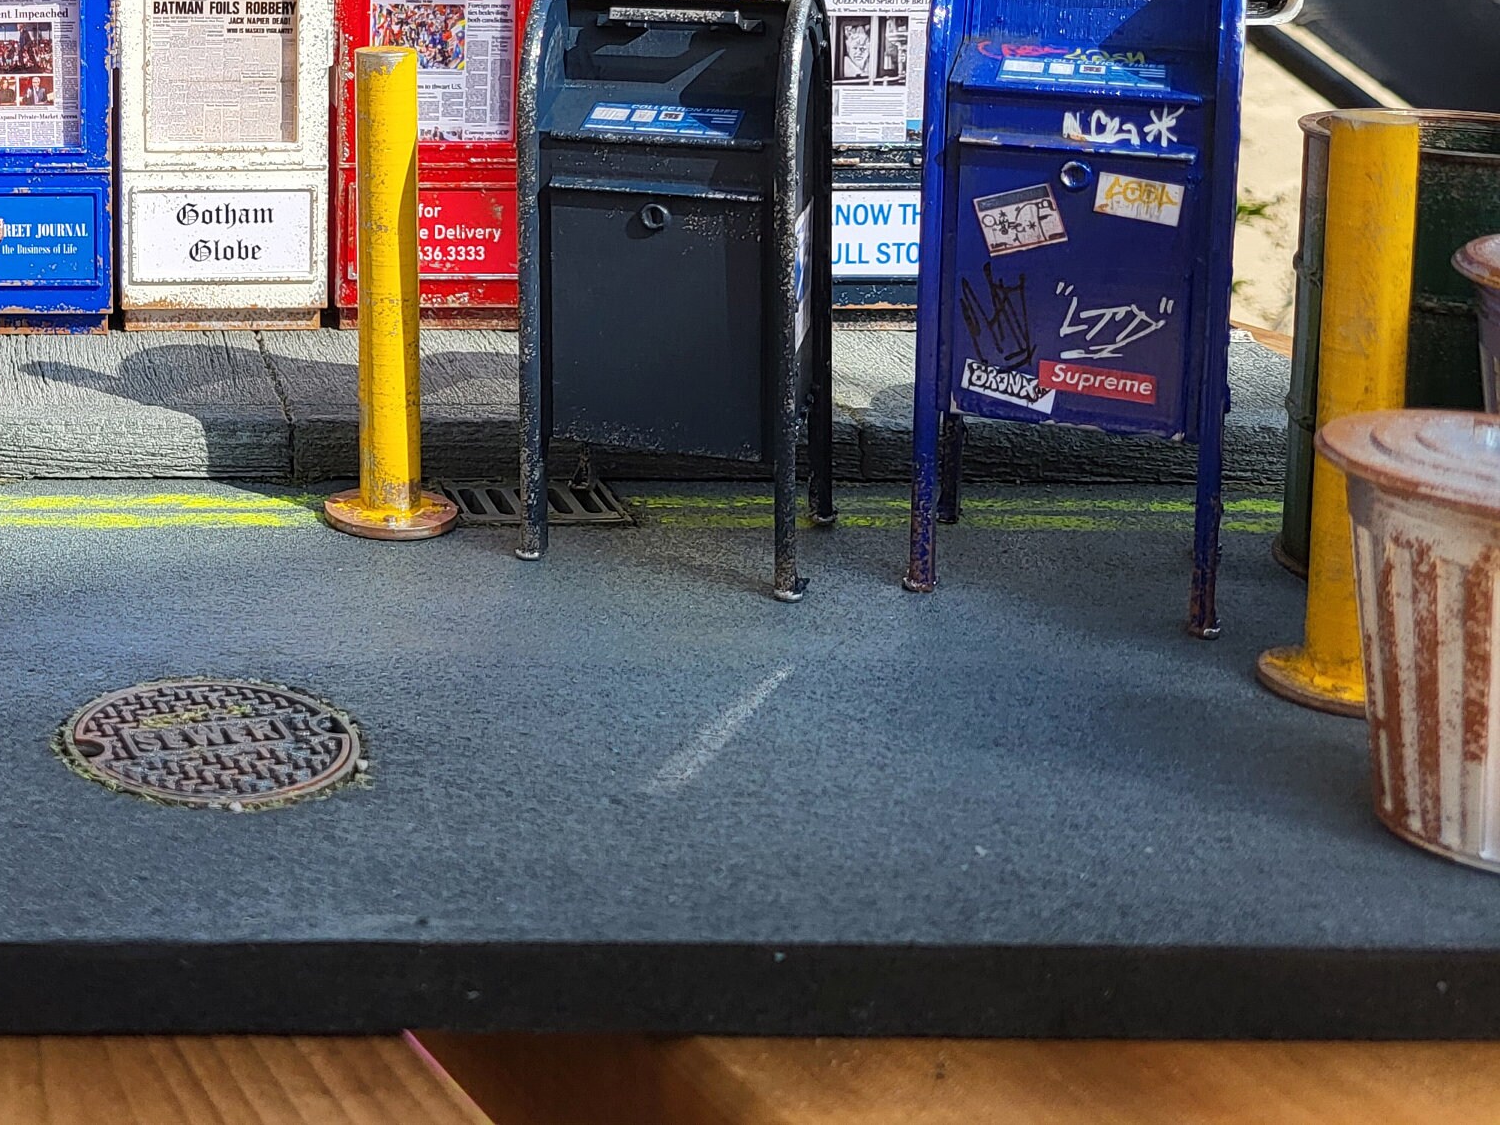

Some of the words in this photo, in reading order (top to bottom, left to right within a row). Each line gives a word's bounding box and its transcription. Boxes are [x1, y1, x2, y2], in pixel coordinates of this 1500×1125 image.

[15, 8, 69, 21] Impeached
[153, 1, 203, 14] BATMAN
[209, 1, 240, 15] FOILS
[245, 1, 297, 15] ROBBERY
[228, 17, 244, 25] JACK
[246, 17, 269, 25] NAPIER
[630, 104, 702, 112] COLLECTION
[175, 202, 275, 229] Gotham
[417, 203, 442, 218] for
[35, 223, 89, 238] JOURNAL
[434, 224, 502, 243] Delivery
[2, 244, 15, 254] the
[17, 244, 51, 255] Business
[52, 244, 62, 254] of
[63, 244, 78, 254] Life
[188, 238, 263, 263] Globe
[968, 360, 1040, 403] BRONX
[1051, 364, 1154, 395] Supreme
[137, 720, 282, 750] SEWER
